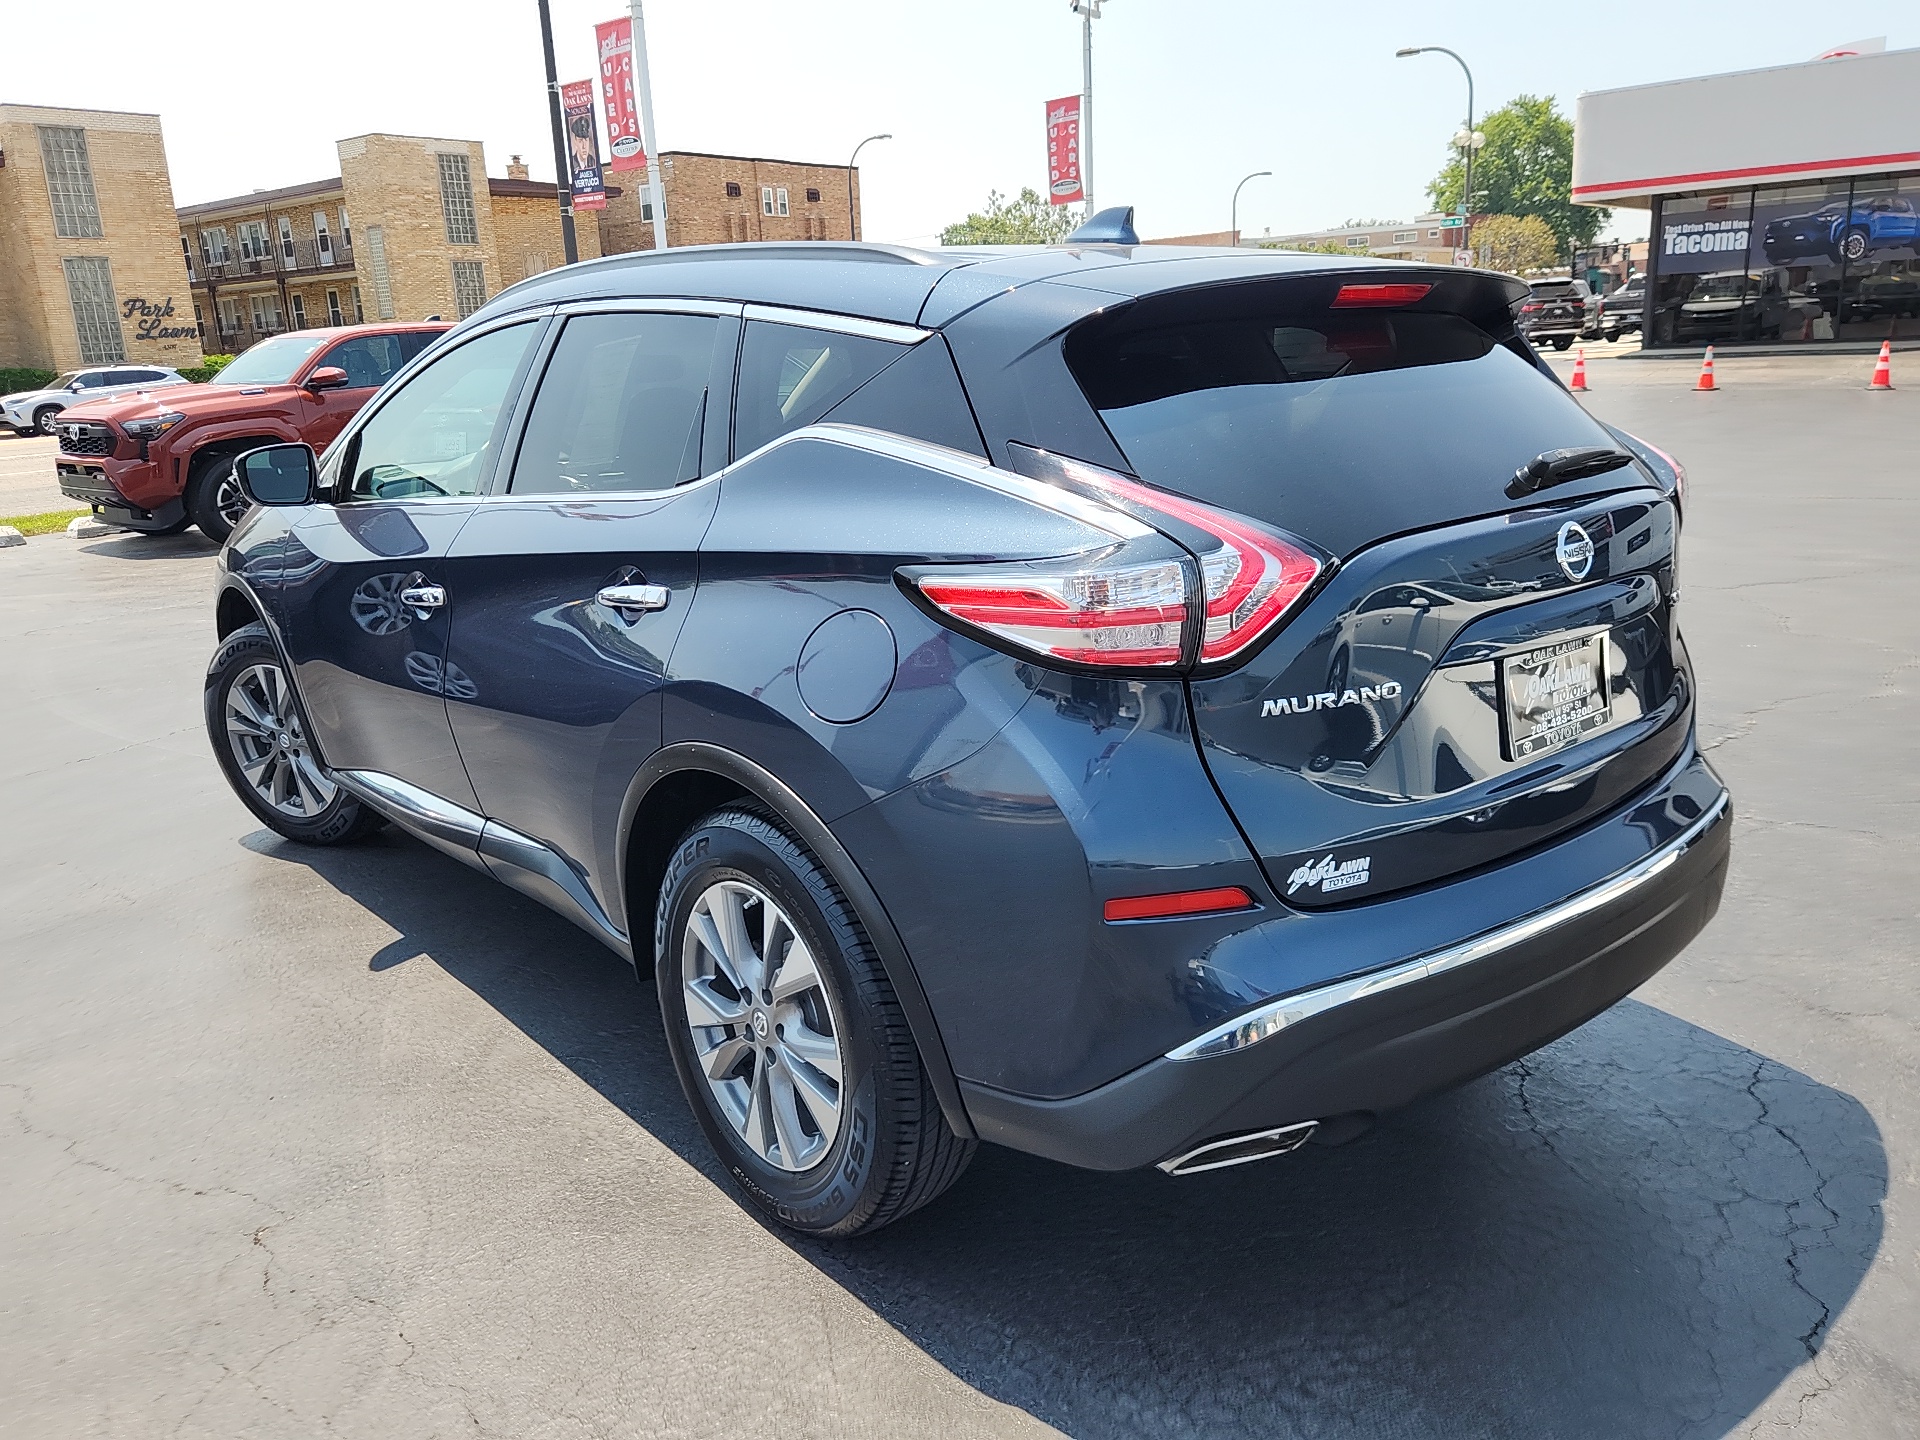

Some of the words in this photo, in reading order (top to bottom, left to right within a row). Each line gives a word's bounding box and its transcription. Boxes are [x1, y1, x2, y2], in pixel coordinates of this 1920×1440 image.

[603, 61, 620, 137] USED
[622, 56, 636, 133] CARS
[1050, 127, 1060, 180] USED
[1068, 123, 1077, 178] CARS
[579, 170, 594, 179] JAMES
[1665, 225, 1682, 233] Test
[1682, 223, 1704, 232] Drive
[1704, 222, 1720, 231] The
[1720, 220, 1732, 230] All
[1663, 230, 1749, 255] Tacoma
[123, 296, 175, 318] Park
[136, 318, 198, 340] Lawn
[1564, 541, 1594, 559] NISSAN
[1533, 648, 1555, 662] OAK
[1555, 639, 1583, 656] LAWN
[1260, 680, 1402, 718] MURANO
[1556, 685, 1591, 703] TOYOTA
[1544, 721, 1584, 746] TOYOTA
[1327, 873, 1363, 888] TOYOTA
